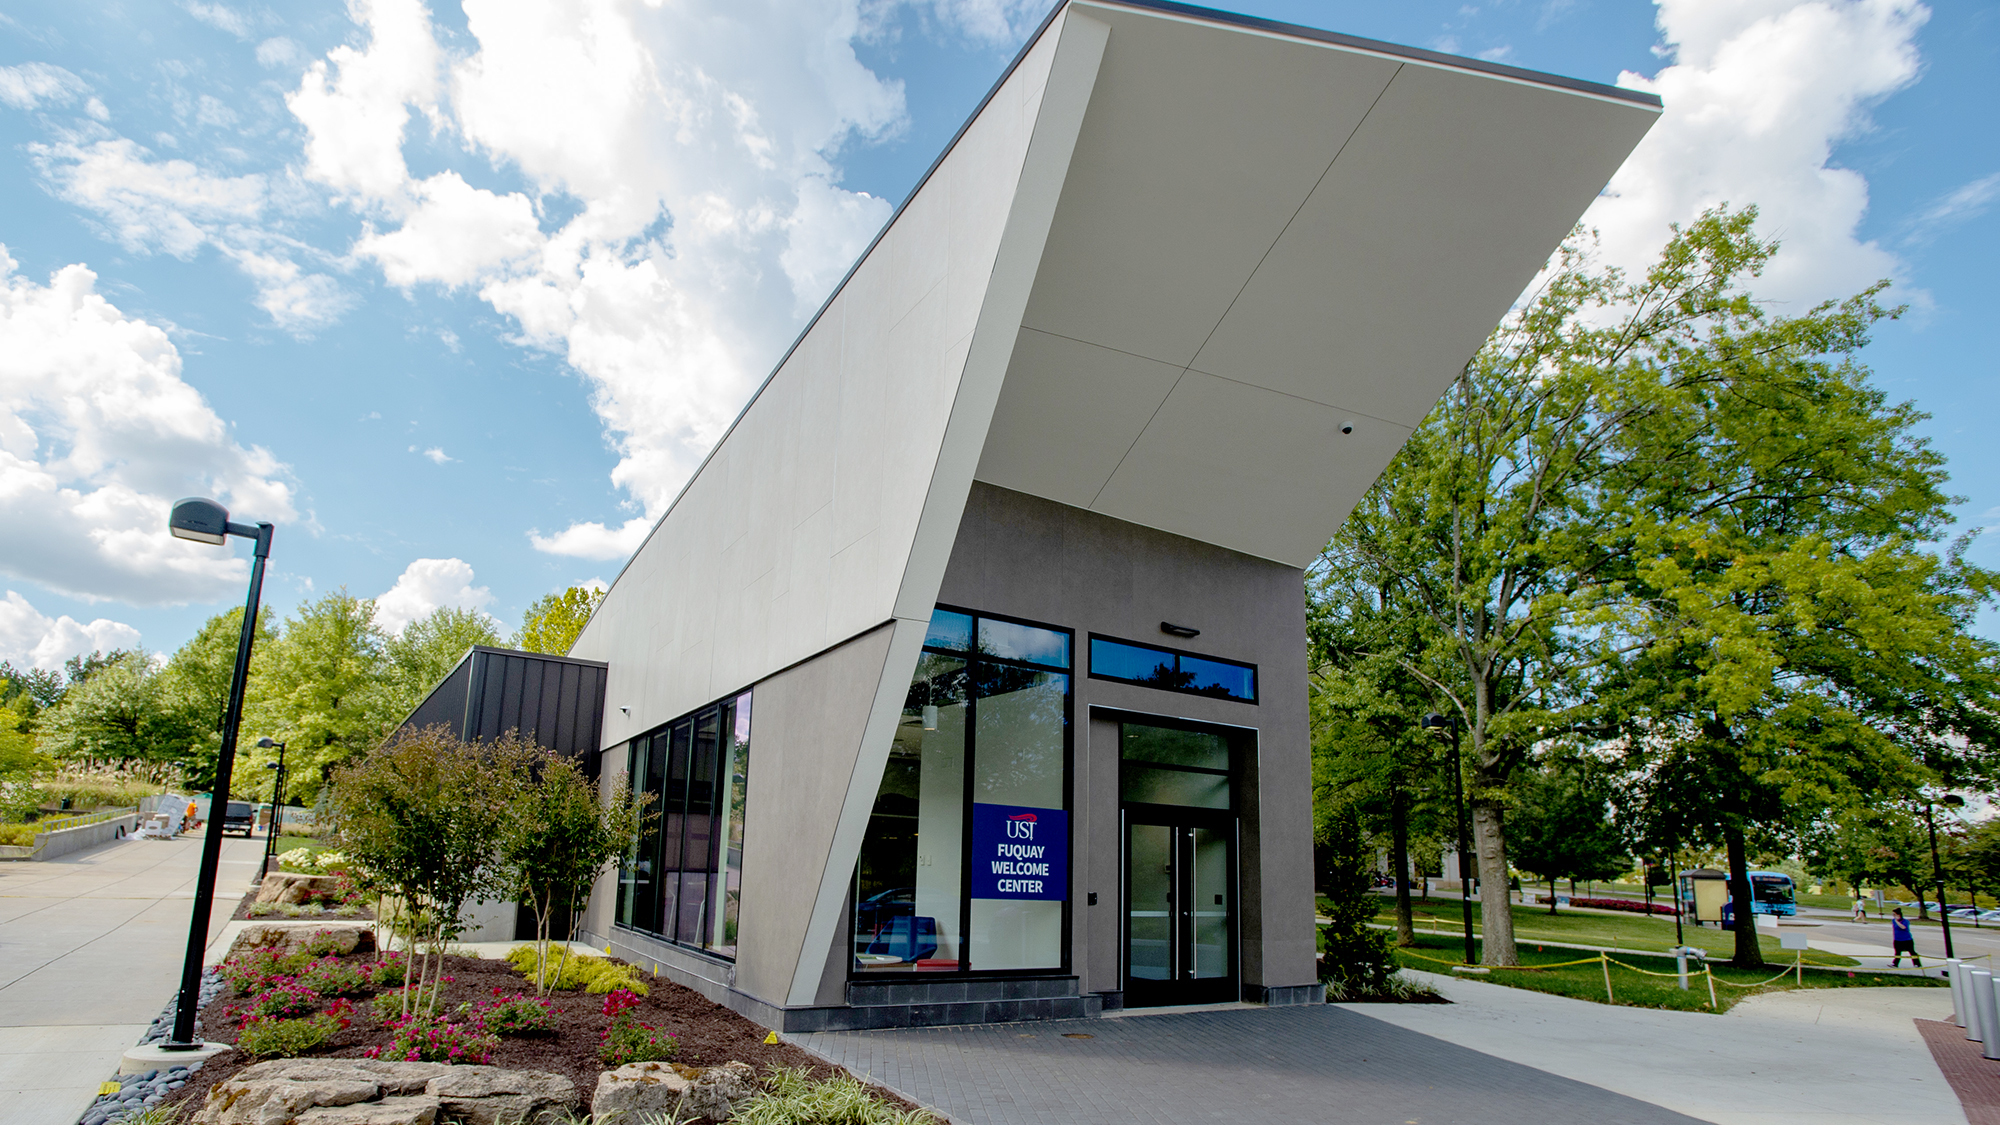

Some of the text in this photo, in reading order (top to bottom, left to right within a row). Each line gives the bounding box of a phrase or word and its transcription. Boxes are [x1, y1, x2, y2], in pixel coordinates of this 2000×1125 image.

[1006, 820, 1036, 841] USI
[997, 843, 1045, 860] FUQUAY
[991, 861, 1049, 876] WELCOME
[997, 879, 1043, 893] CENTER
